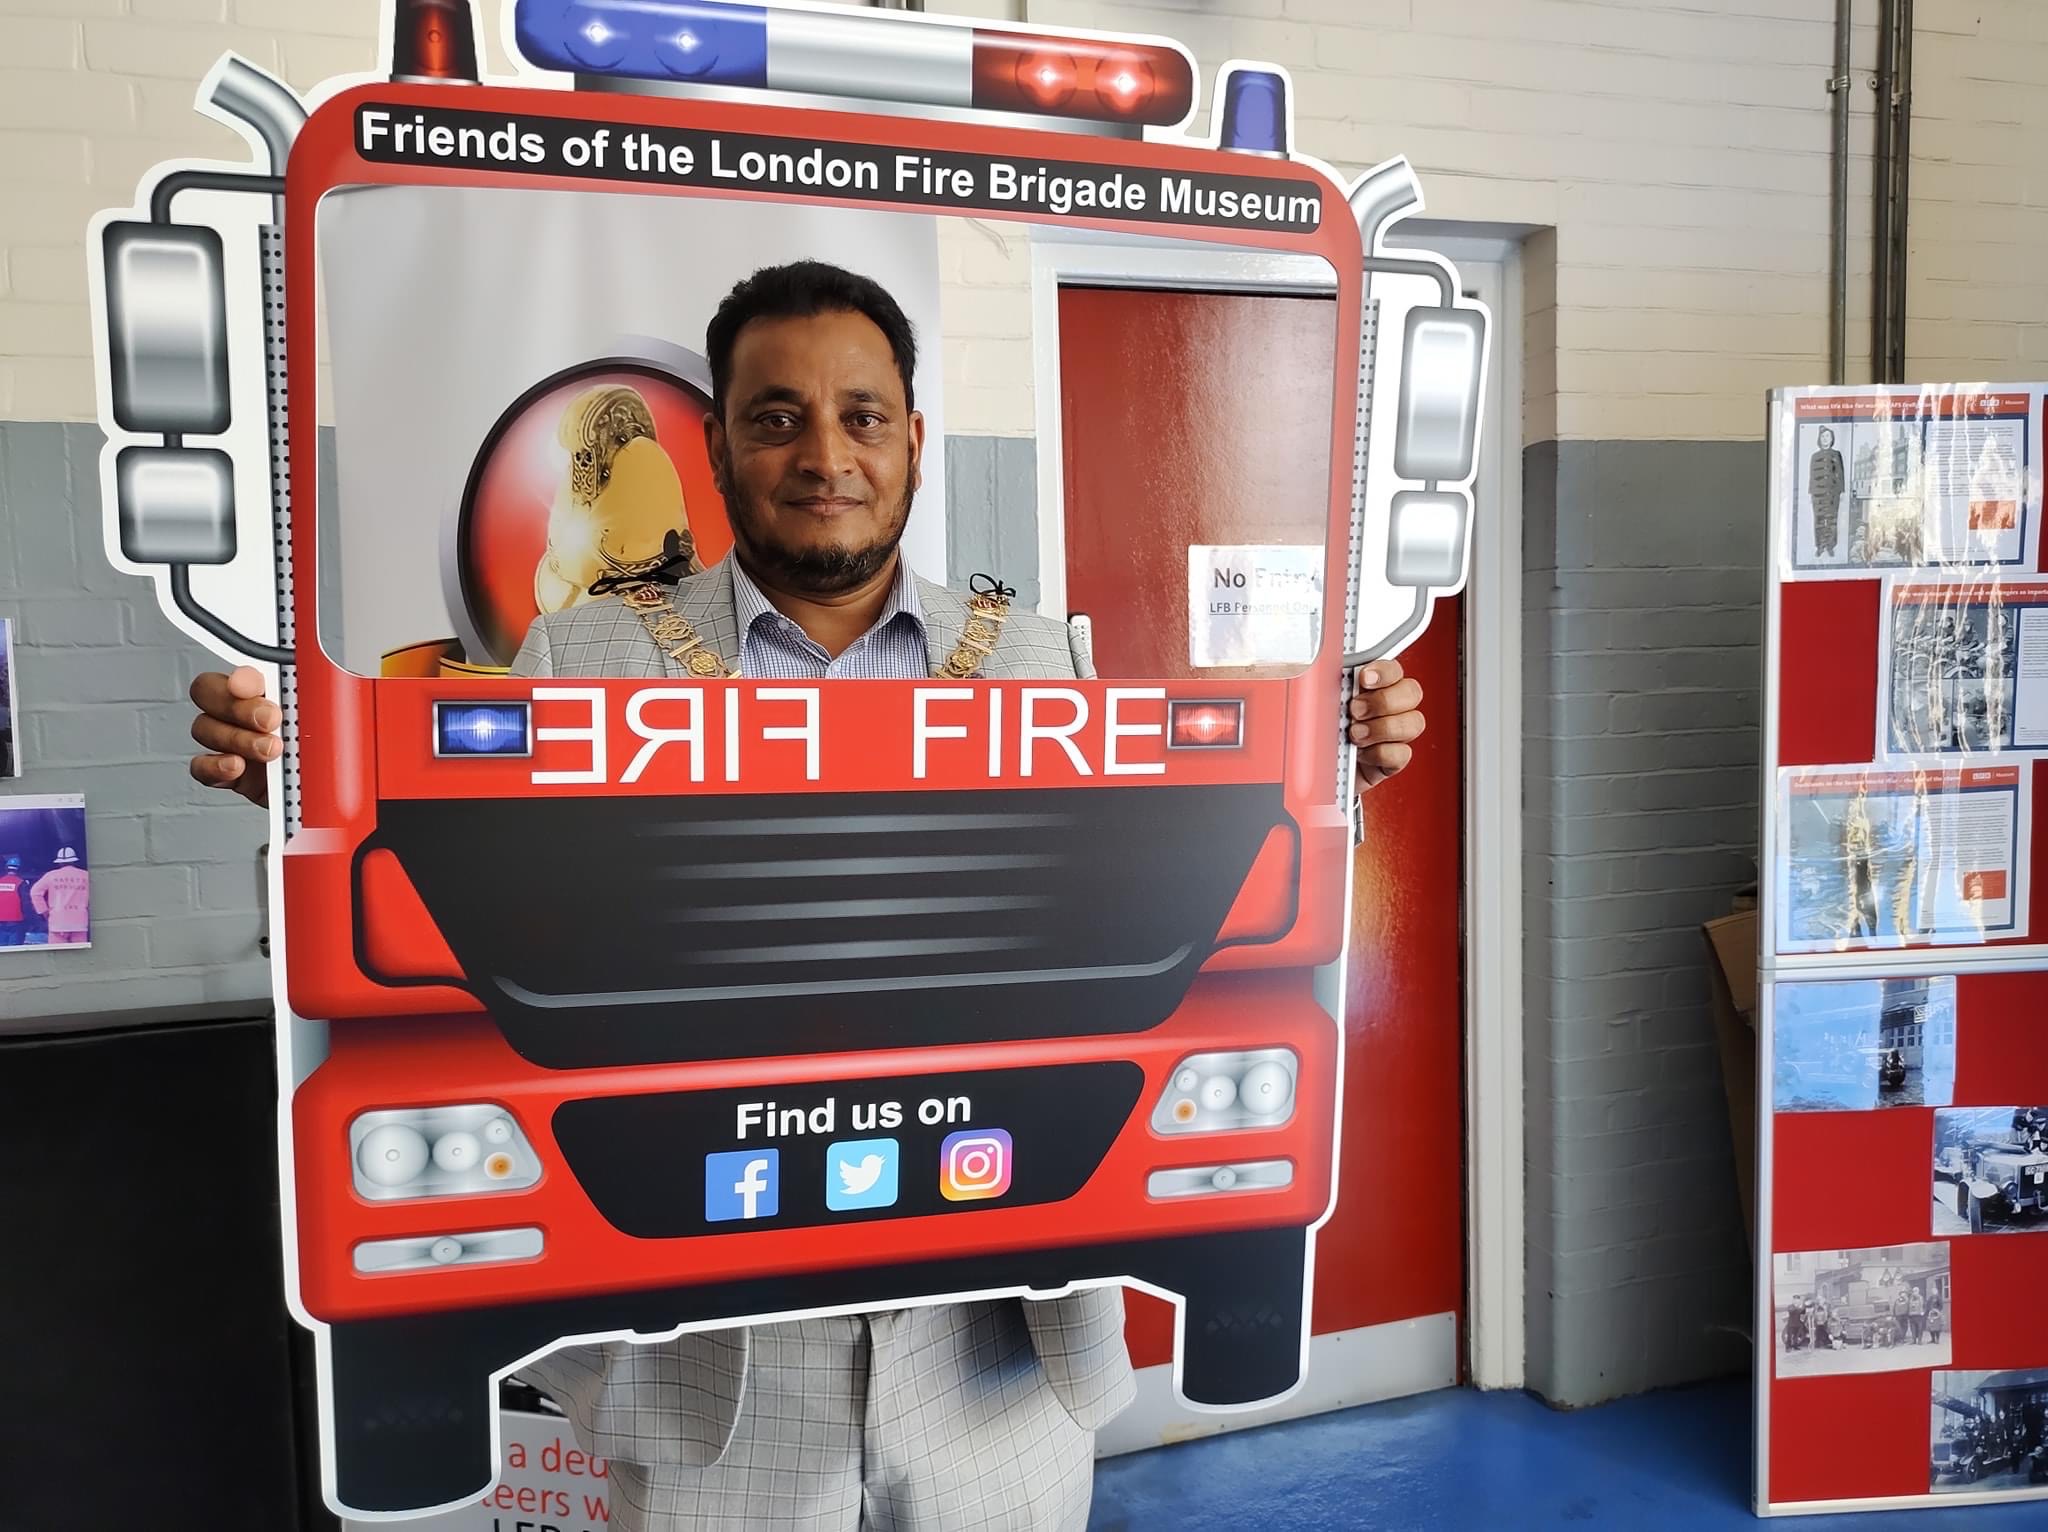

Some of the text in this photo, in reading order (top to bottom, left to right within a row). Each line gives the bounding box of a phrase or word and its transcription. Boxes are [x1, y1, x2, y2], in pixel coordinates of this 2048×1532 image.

[361, 110, 1322, 224] Friends of the London Fire Brigade Museum
[1213, 567, 1247, 588] No
[1209, 602, 1231, 613] LFB
[912, 687, 1167, 779] FIRE
[736, 1095, 972, 1140] Find us on
[508, 1442, 527, 1469] a
[482, 1484, 571, 1517] eers
